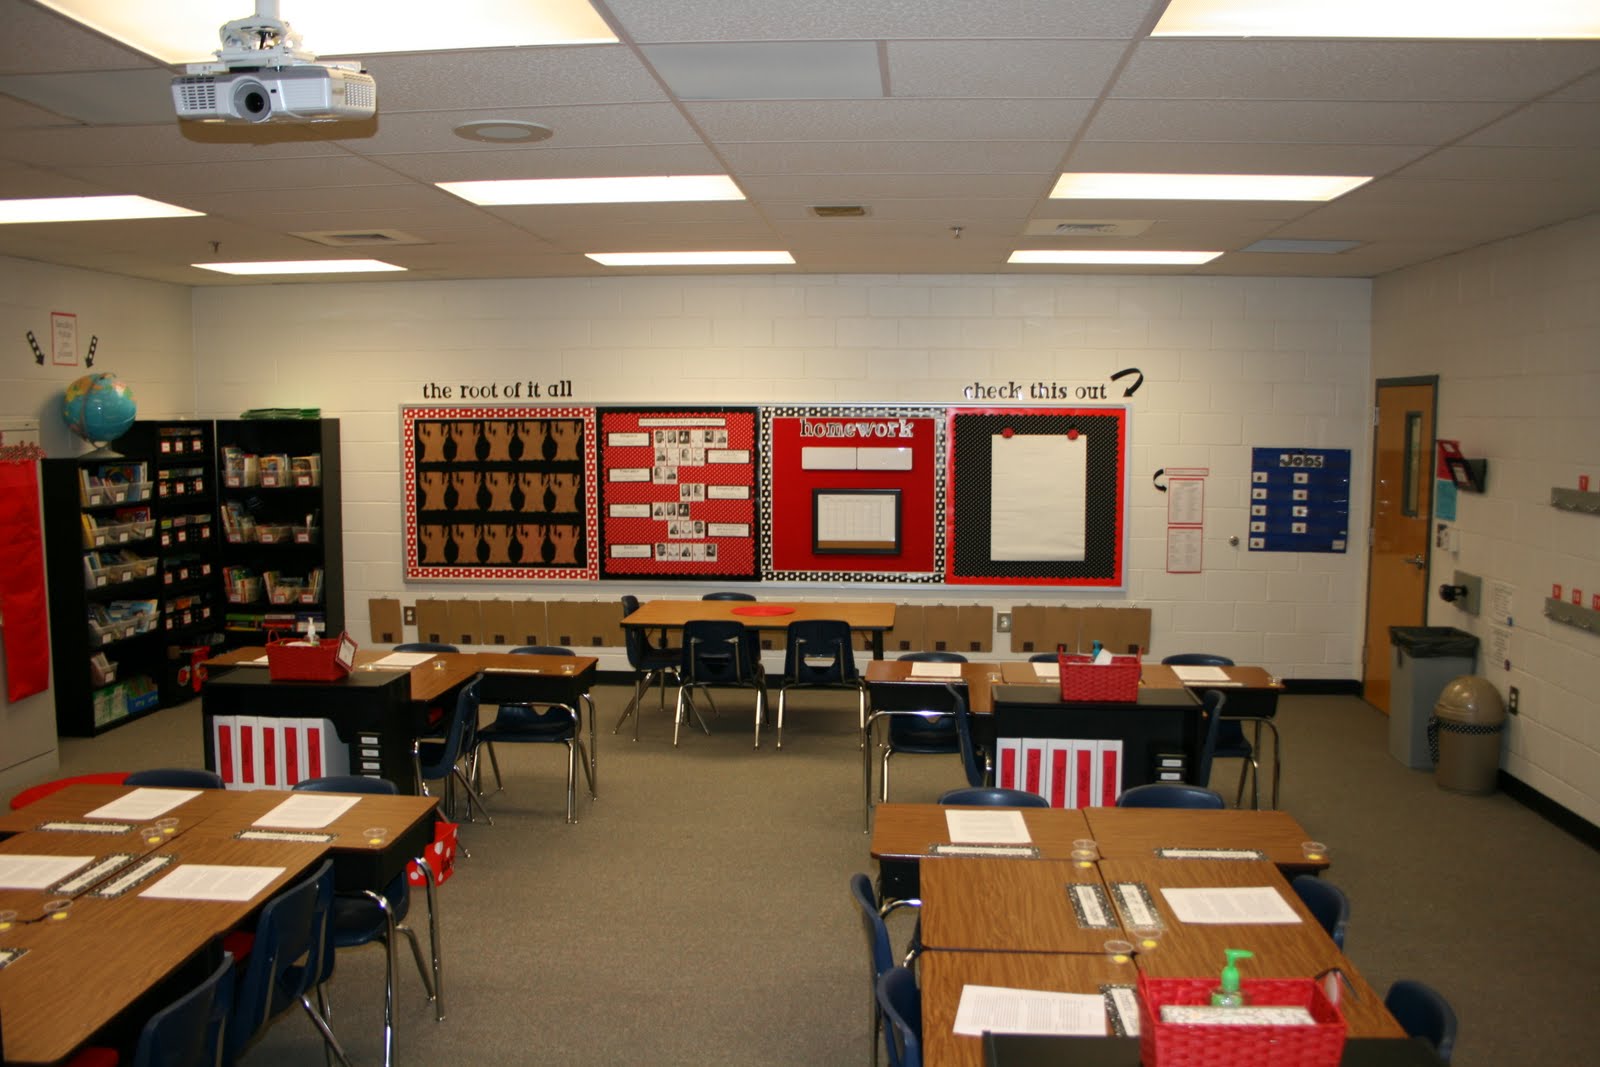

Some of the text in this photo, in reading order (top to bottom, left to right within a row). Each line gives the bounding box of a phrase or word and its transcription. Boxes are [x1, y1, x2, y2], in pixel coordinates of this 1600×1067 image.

[423, 380, 573, 399] the root of it all
[963, 381, 1107, 399] check this out
[800, 418, 914, 437] homework
[1280, 453, 1322, 467] Jobs
